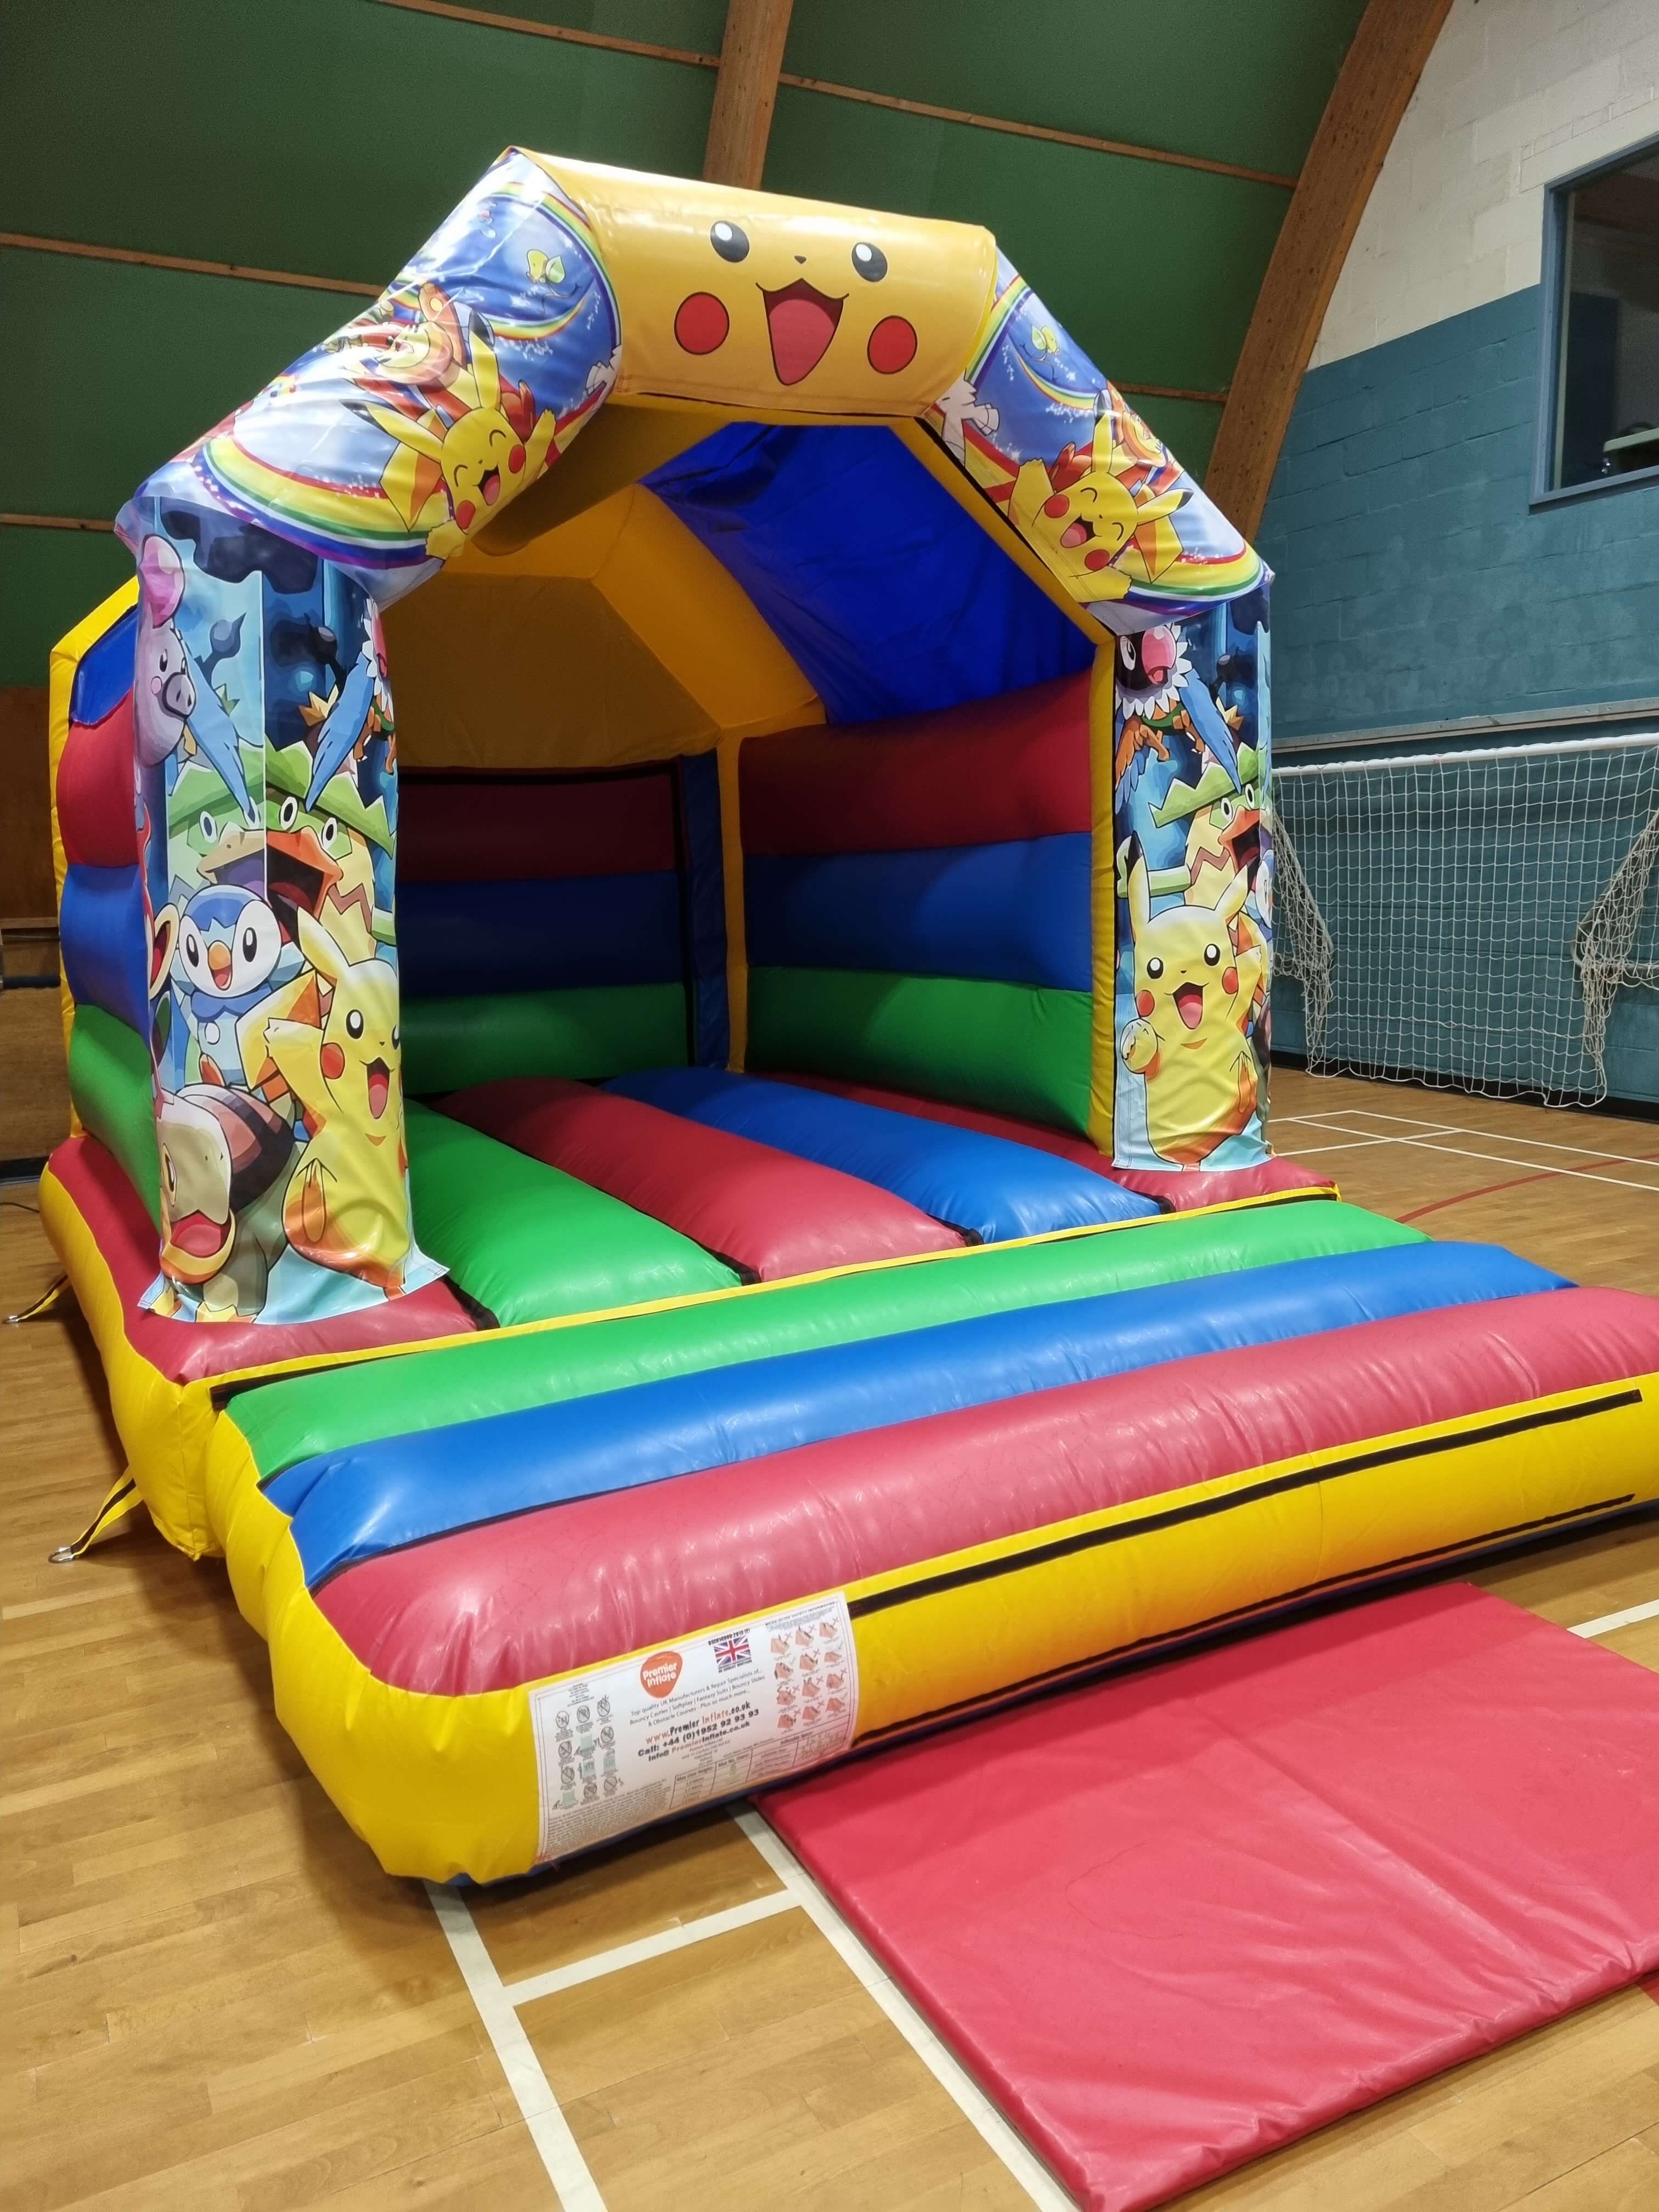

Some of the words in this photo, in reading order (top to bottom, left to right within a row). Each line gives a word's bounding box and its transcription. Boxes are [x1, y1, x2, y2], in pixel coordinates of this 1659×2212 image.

[642, 1661, 678, 1681] Premier
[647, 1671, 678, 1688] Inflate
[630, 1716, 650, 1725] Bouncy
[650, 1708, 668, 1718] Castles
[672, 1700, 693, 1711] Softplay
[696, 1692, 715, 1702] Fantasy
[732, 1680, 750, 1690] Bouncy
[642, 1703, 659, 1713] quality
[669, 1689, 706, 1703] Manufacturers
[711, 1680, 726, 1689] Repair
[727, 1671, 753, 1684] Specialists
[653, 1713, 675, 1725] Obstacle
[676, 1707, 696, 1718] Courses
[718, 1694, 733, 1702] much
[637, 1745, 659, 1757] Call:
[662, 1736, 680, 1747] +44
[682, 1723, 718, 1743] (0)1952
[720, 1718, 731, 1728] 92
[734, 1713, 746, 1723] 93
[748, 1708, 759, 1718] 93
